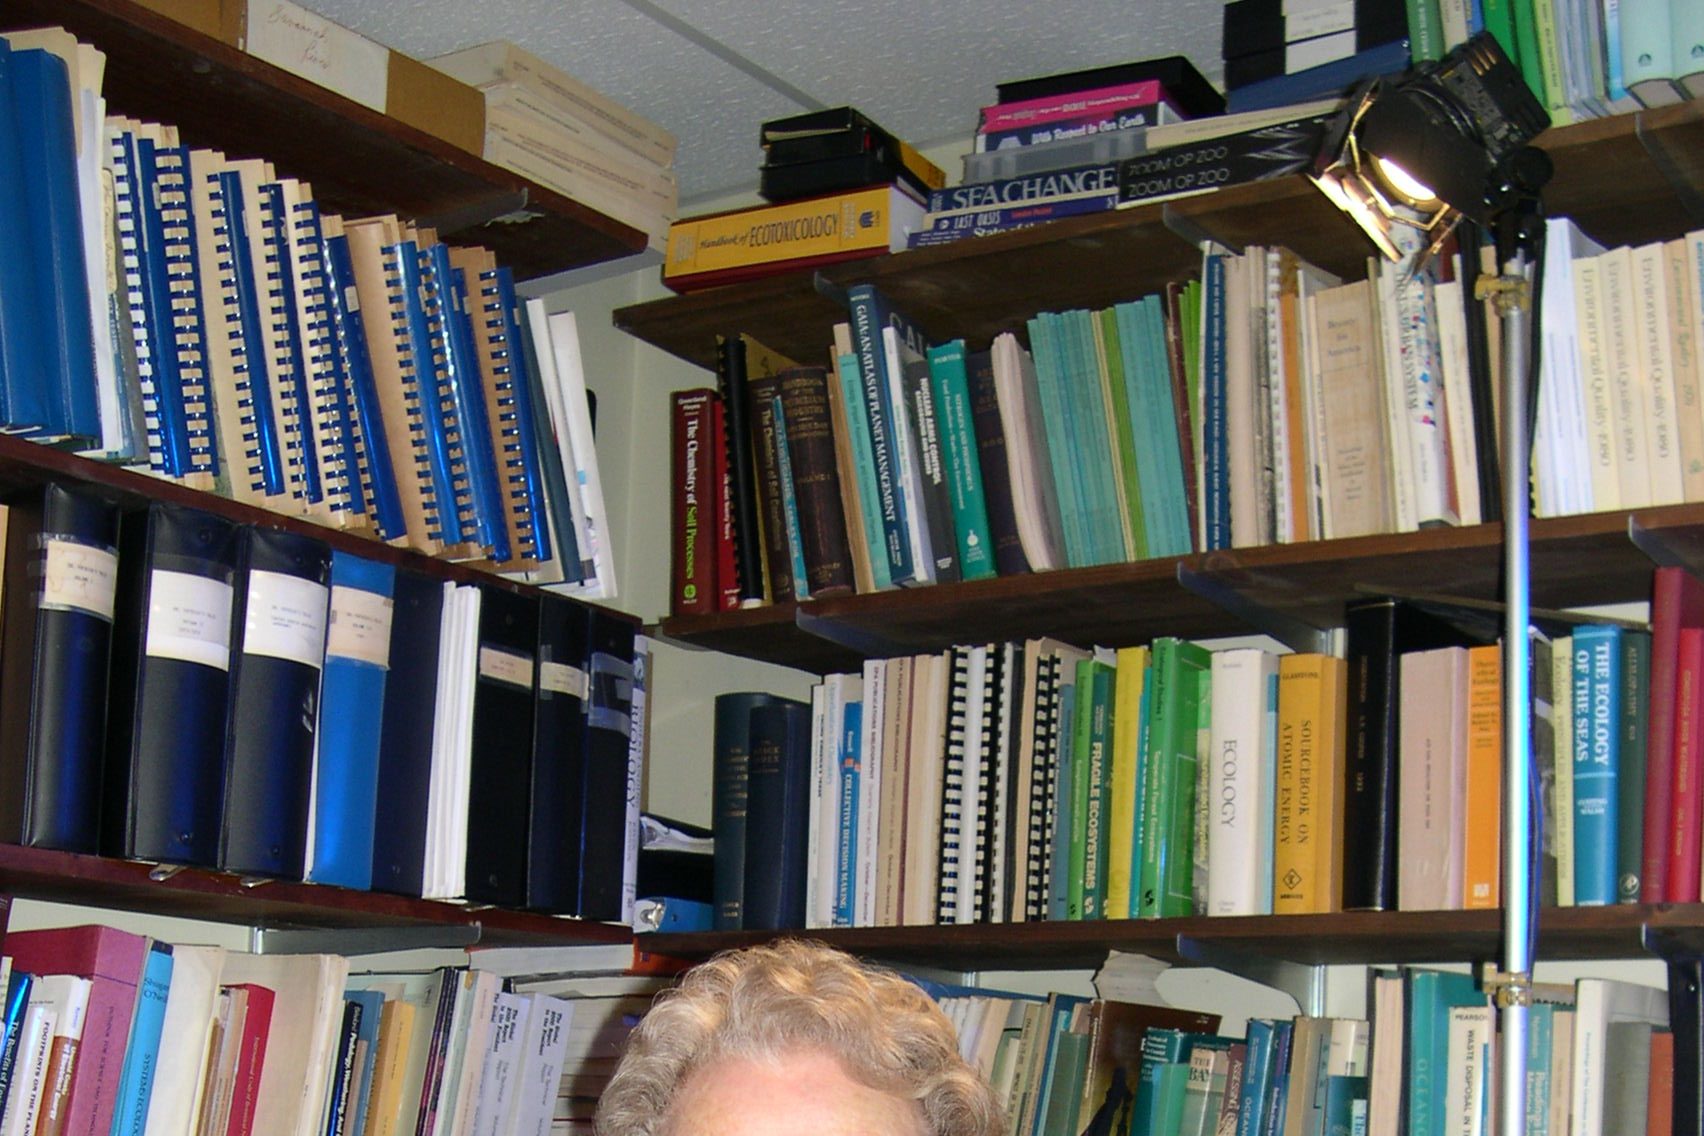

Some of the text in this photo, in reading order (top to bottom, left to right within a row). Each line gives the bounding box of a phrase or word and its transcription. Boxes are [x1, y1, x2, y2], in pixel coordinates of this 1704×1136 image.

[1118, 113, 1146, 130] Earth
[1127, 167, 1231, 198] ZOOM OP ZOO
[1128, 145, 1229, 176] ZOOM OP ZOO
[951, 167, 1117, 211] SEA CHANGE
[700, 213, 839, 249] Handbook of ECOTOXICOLOGY
[953, 211, 1001, 229] LAST OASIS
[1581, 269, 1603, 376] Environmental
[1607, 261, 1631, 369] Environmental
[1641, 257, 1661, 365] Environmental
[855, 304, 896, 522] GAIA: AN ATLAS OF PLANET MANAGEMENT
[919, 378, 942, 486] NUCLEAR ARMS CONTROL
[685, 420, 698, 579] The Chemistry of Soil Processes
[1554, 655, 1566, 705] Ecology
[1627, 646, 1638, 717] ALLELOPATHY
[826, 682, 837, 737] Opportunities
[893, 673, 903, 772] PUBLICATIONS BIBLIOGRAPHY
[1575, 650, 1589, 762] OF THE SEAS
[1594, 642, 1610, 766] THE ECOLOGY
[825, 744, 835, 785] Chemistry
[1090, 742, 1103, 798] FRAGILE
[1220, 740, 1237, 828] ECOLOGY
[1280, 722, 1293, 845] ATOMIC ENERGY
[1297, 720, 1313, 845] SOURCEBOOK ON
[1147, 750, 1162, 863] Temperate Forest Ecosystems
[839, 774, 852, 909] COLLECTIVE DECISION MAKING
[1085, 800, 1100, 889] ECOSYSTEMS
[7, 1021, 20, 1038] The
[501, 1024, 510, 1044] Report
[507, 1009, 519, 1041] The Global
[538, 1028, 548, 1057] President
[546, 1027, 554, 1047] Report
[552, 1012, 563, 1044] The Global
[1464, 1029, 1476, 1062] WASTE
[0, 1038, 17, 1071] Benefits
[33, 1021, 51, 1078] FOOTPRINTS
[344, 1032, 358, 1069] Pedology,
[30, 1079, 39, 1092] ON
[136, 1053, 152, 1098] SYSTEMS
[338, 1069, 352, 1115] Weathering,
[1463, 1065, 1474, 1112] DISPOSAL
[26, 1094, 37, 1111] THE
[1463, 1115, 1473, 1126] IN
[1532, 1071, 1546, 1128] Readings
[335, 1117, 345, 1133] And
